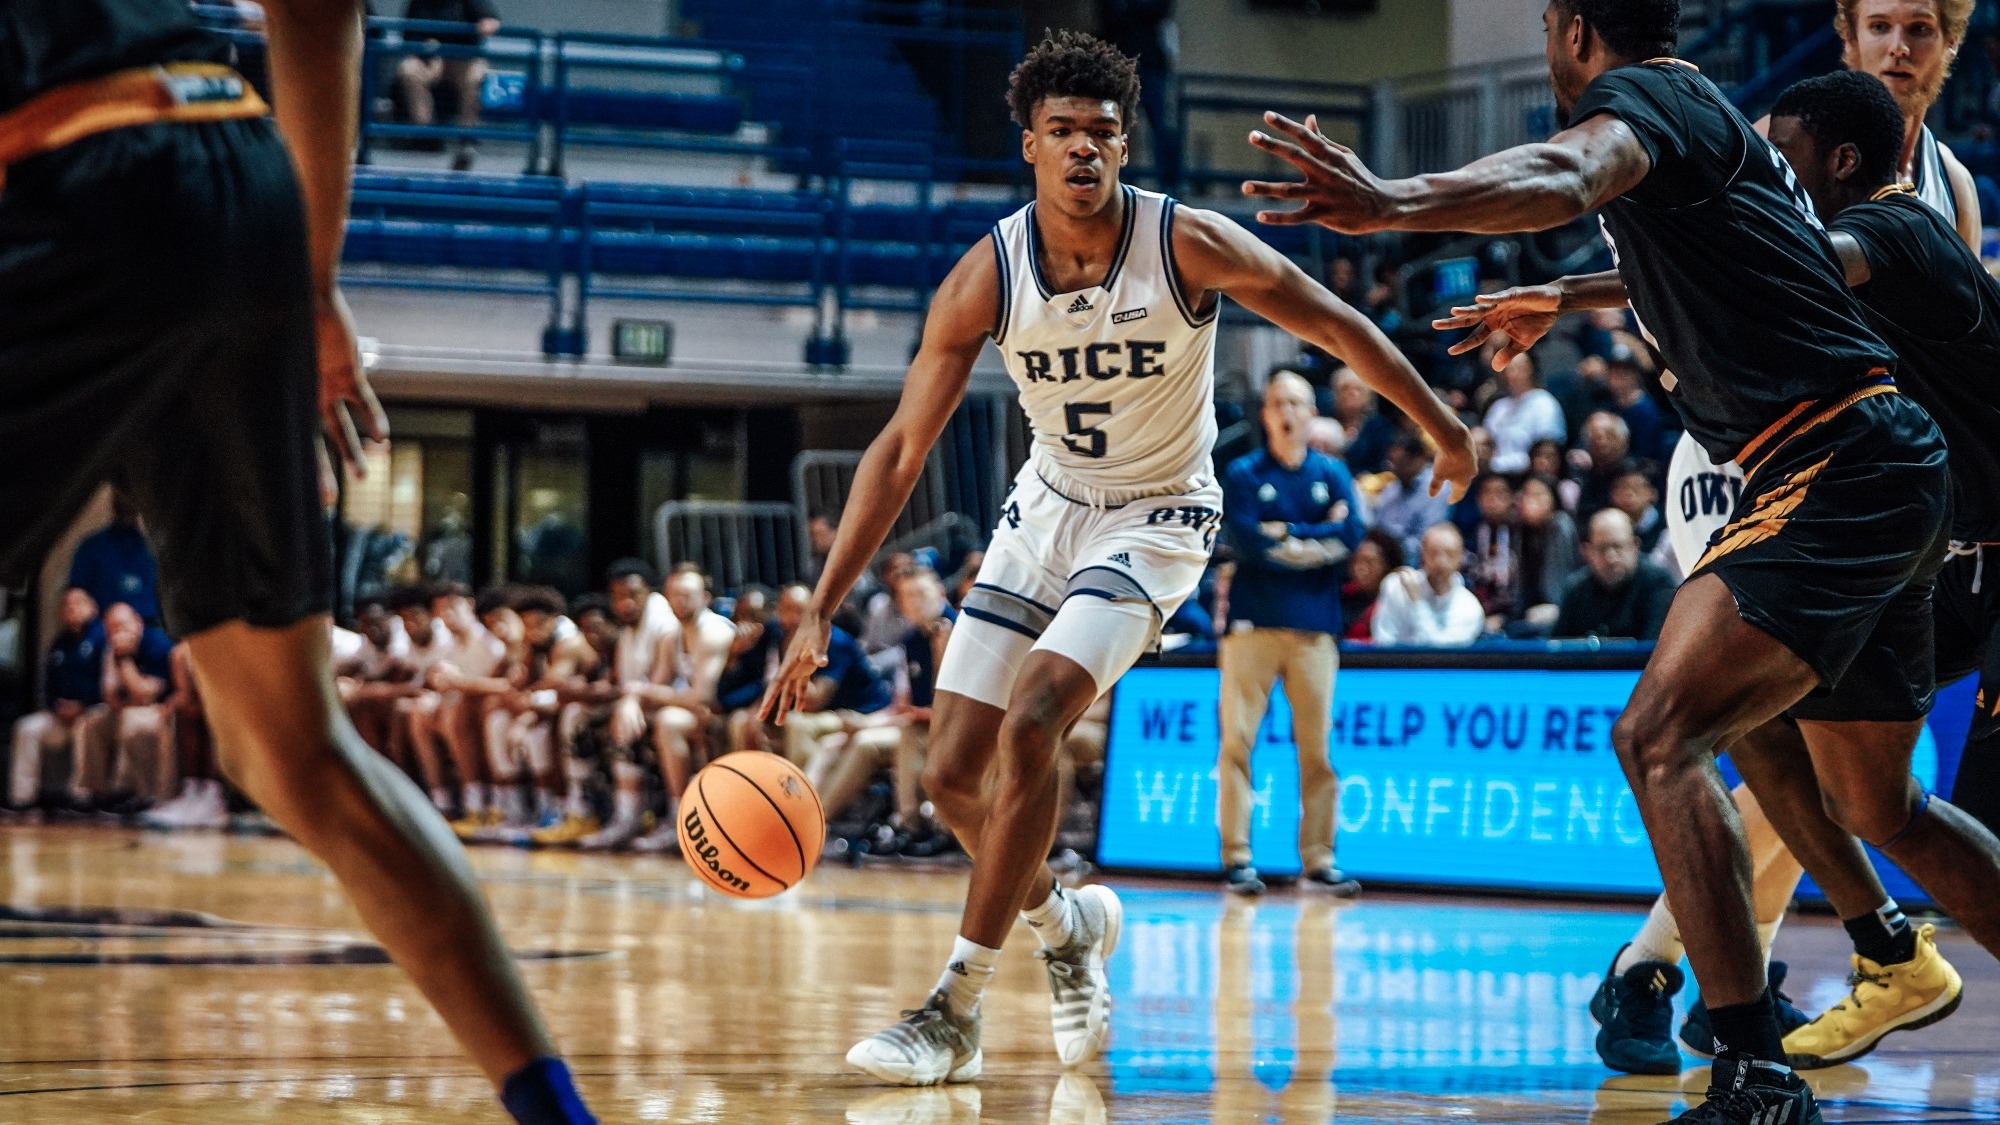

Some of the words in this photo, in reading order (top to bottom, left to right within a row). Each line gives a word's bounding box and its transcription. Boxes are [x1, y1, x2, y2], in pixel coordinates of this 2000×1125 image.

[1067, 304, 1094, 313] adidas
[1112, 308, 1147, 324] C-USA
[1017, 340, 1166, 383] RICE
[1061, 401, 1112, 458] 5
[1139, 701, 1197, 742] WE
[1443, 704, 1528, 750] YOU
[1543, 706, 1621, 751] RET
[1134, 769, 1274, 829] WIH
[1337, 774, 1648, 845] ONFIDENC
[685, 806, 750, 891] Wilson
